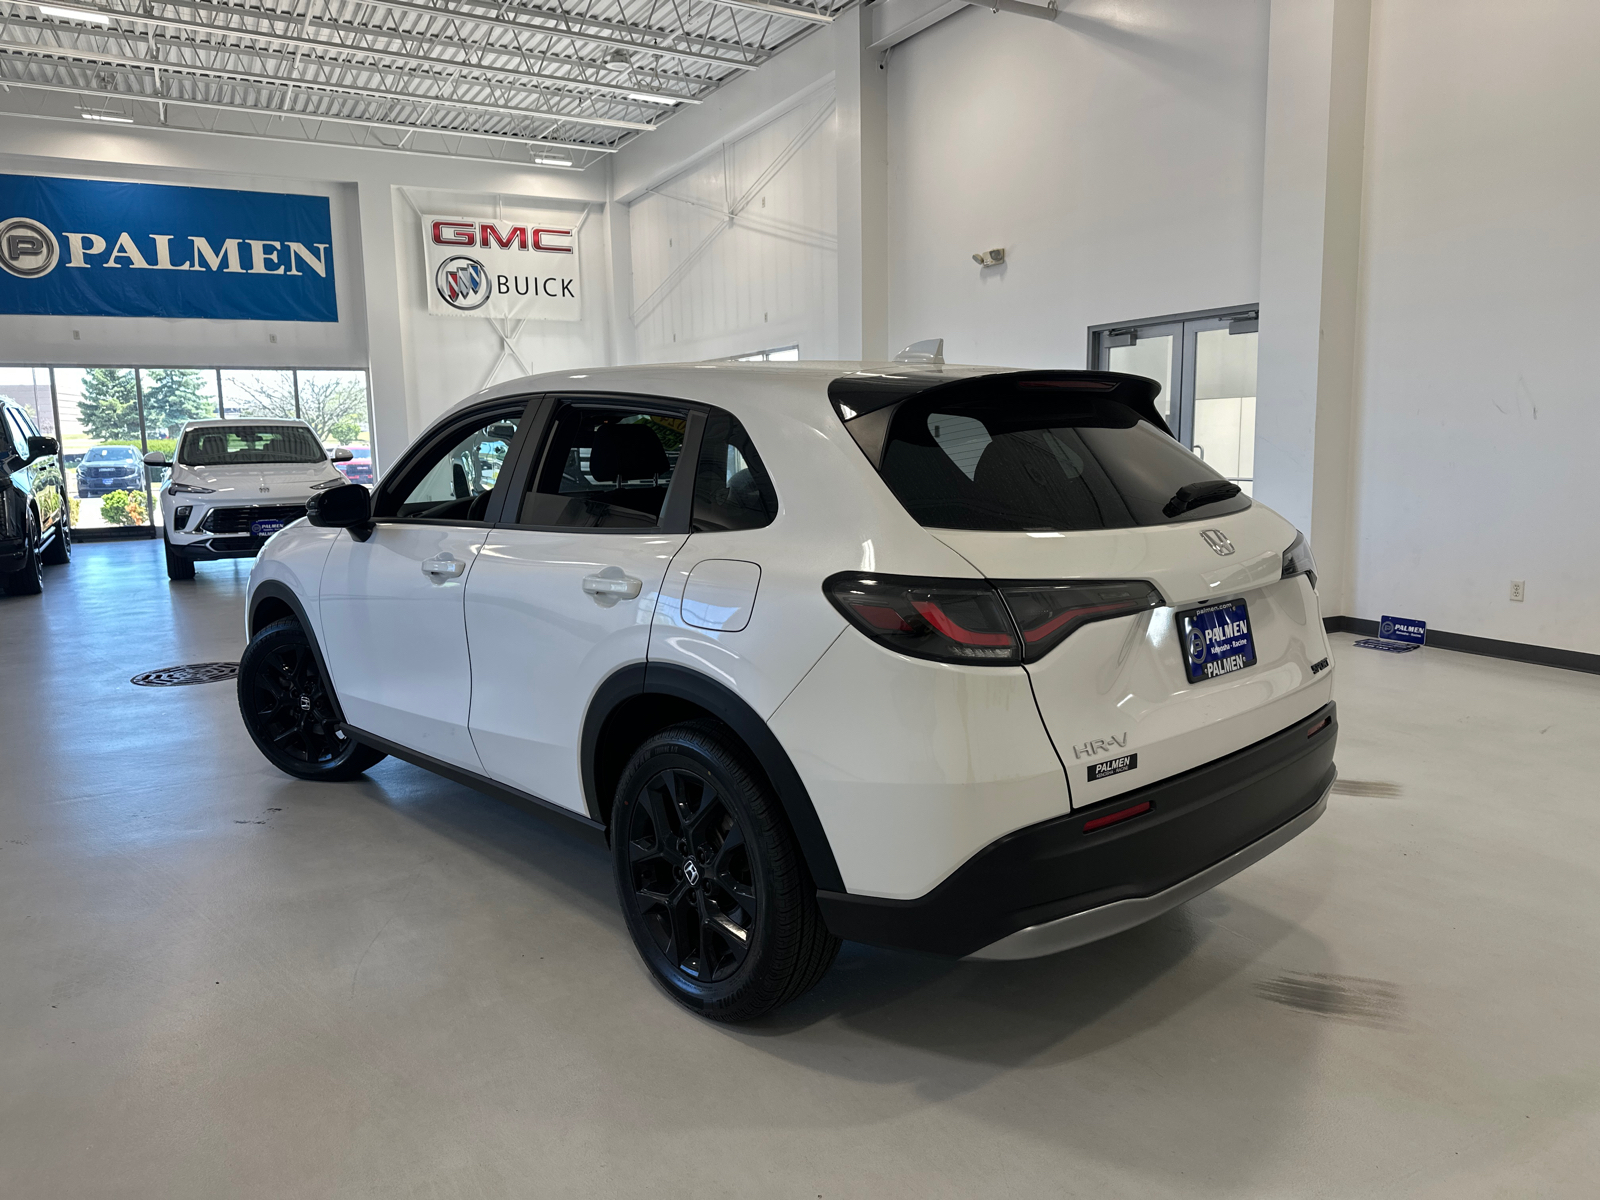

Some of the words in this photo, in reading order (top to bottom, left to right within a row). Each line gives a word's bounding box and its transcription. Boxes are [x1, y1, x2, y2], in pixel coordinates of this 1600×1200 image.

[431, 219, 573, 254] GMC
[62, 231, 329, 278] PALMEN
[497, 275, 575, 298] BUICK
[1196, 603, 1232, 615] palmen.com
[1205, 620, 1247, 644] PALMEN
[1394, 624, 1425, 634] PALMEN
[1207, 654, 1244, 678] PALMEN
[1072, 731, 1128, 760] HR-V
[1095, 755, 1131, 774] PALMEN
